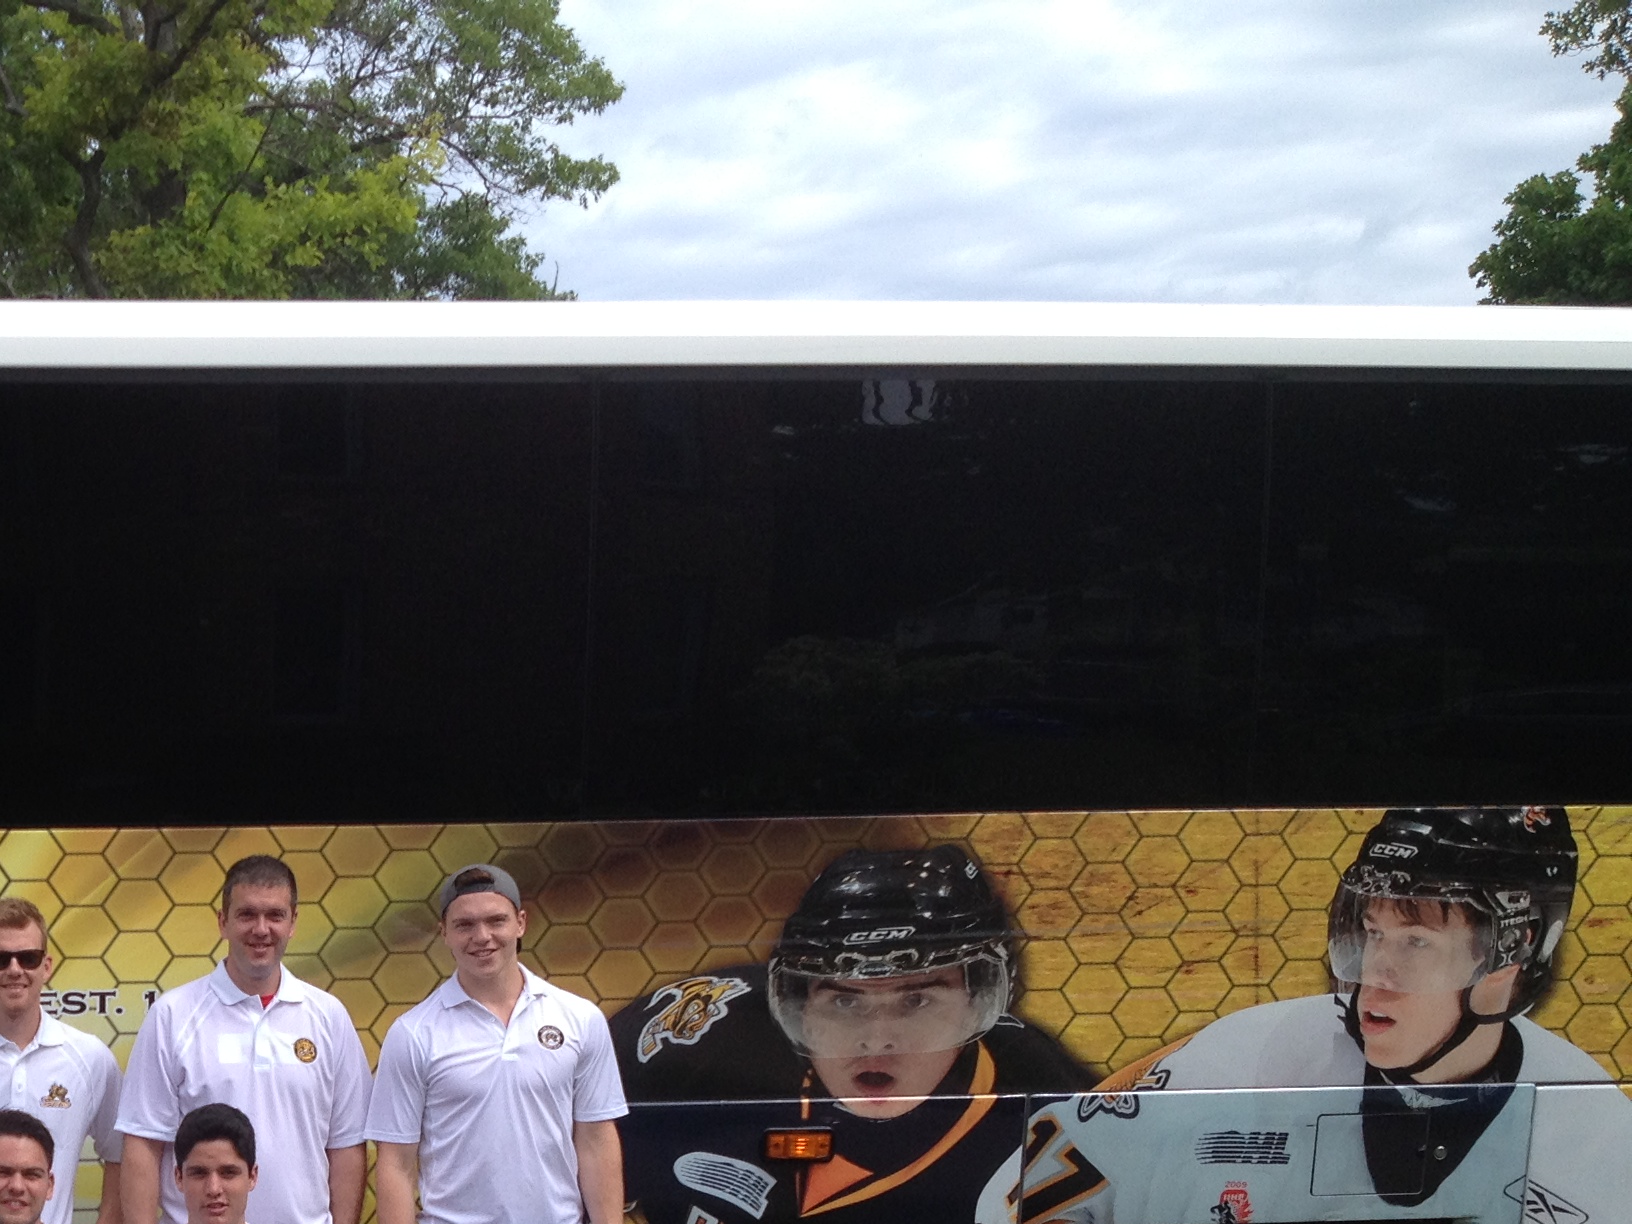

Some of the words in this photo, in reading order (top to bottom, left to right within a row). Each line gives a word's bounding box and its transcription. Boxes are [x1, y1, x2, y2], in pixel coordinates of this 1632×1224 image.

[1373, 843, 1414, 859] CCM
[849, 929, 909, 943] CCM
[40, 991, 123, 1014] EST.
